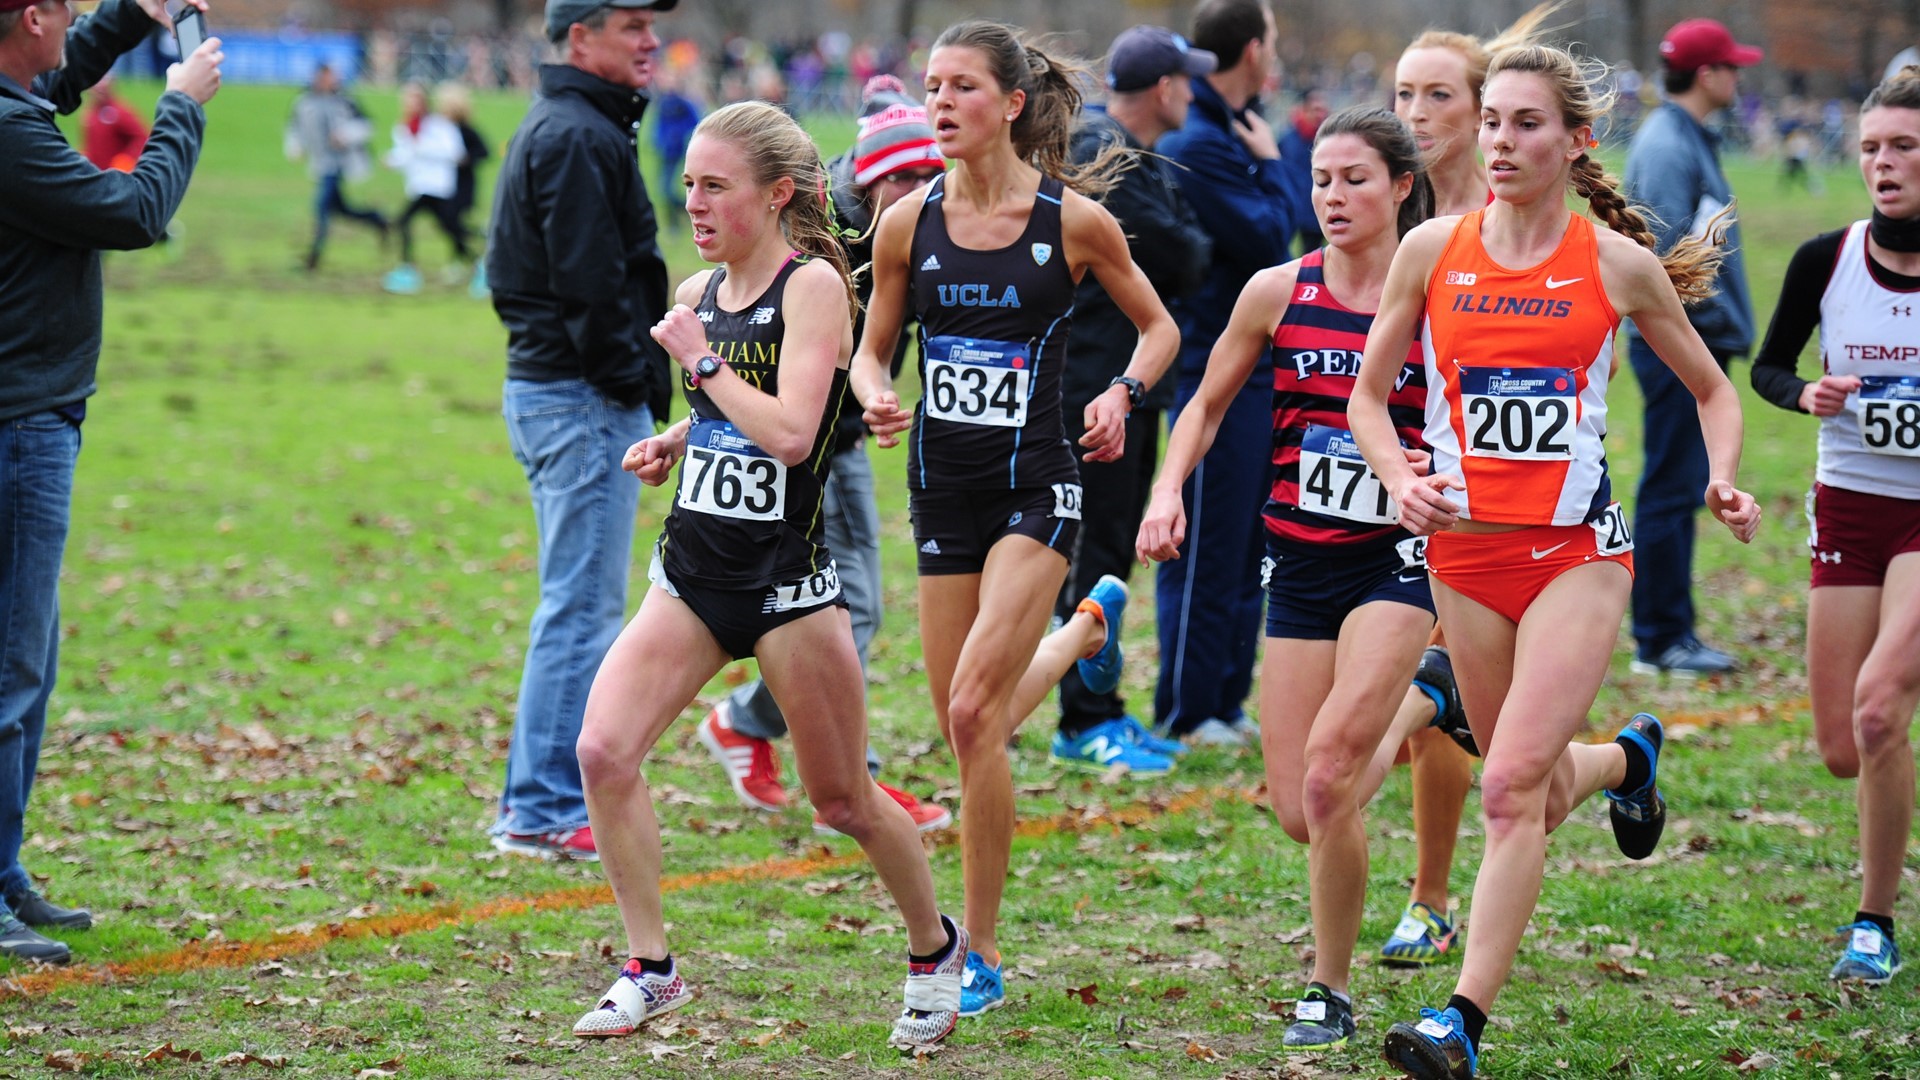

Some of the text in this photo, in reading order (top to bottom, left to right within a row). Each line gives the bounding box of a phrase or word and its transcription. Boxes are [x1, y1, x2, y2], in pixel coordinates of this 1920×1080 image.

[938, 284, 1021, 308] UCLA
[1452, 294, 1573, 318] ILLINOIS
[1845, 345, 1920, 361] TEMP
[932, 364, 1021, 419] 634
[1469, 397, 1570, 453] 202
[1865, 402, 1920, 450] 58
[689, 449, 777, 514] 763
